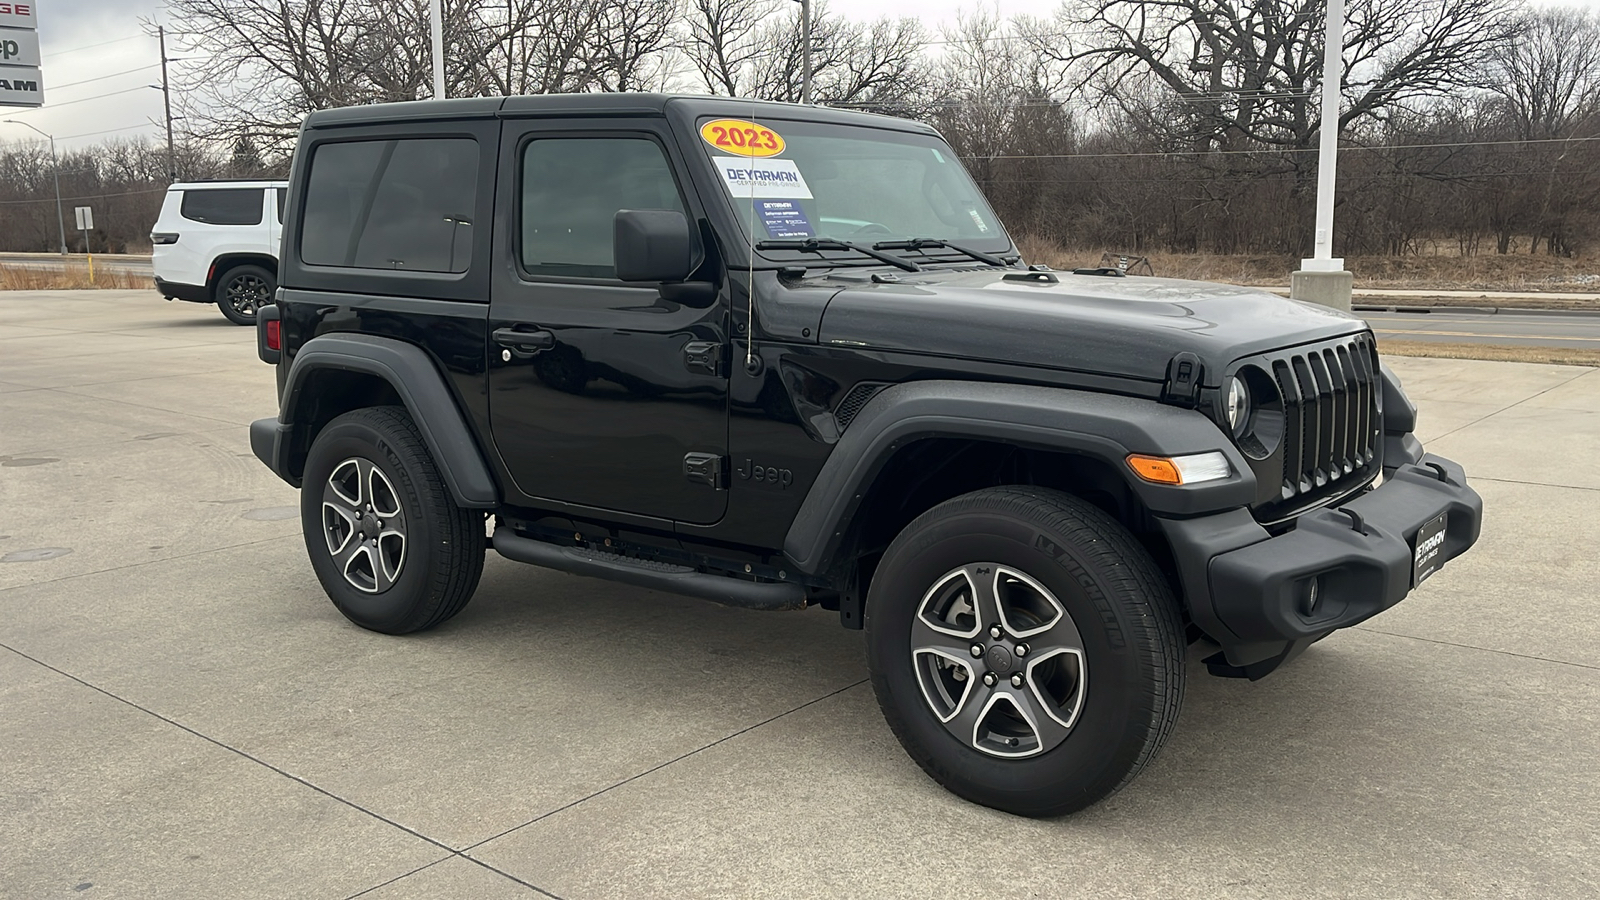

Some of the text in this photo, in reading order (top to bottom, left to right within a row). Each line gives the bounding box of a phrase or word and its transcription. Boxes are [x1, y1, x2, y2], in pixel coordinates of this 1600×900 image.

[712, 126, 778, 150] 2023
[726, 168, 799, 182] DEYARMAN
[737, 458, 794, 490] Jeep
[1415, 529, 1446, 562] DEYARMAN
[1056, 553, 1126, 647] MICHELIN
